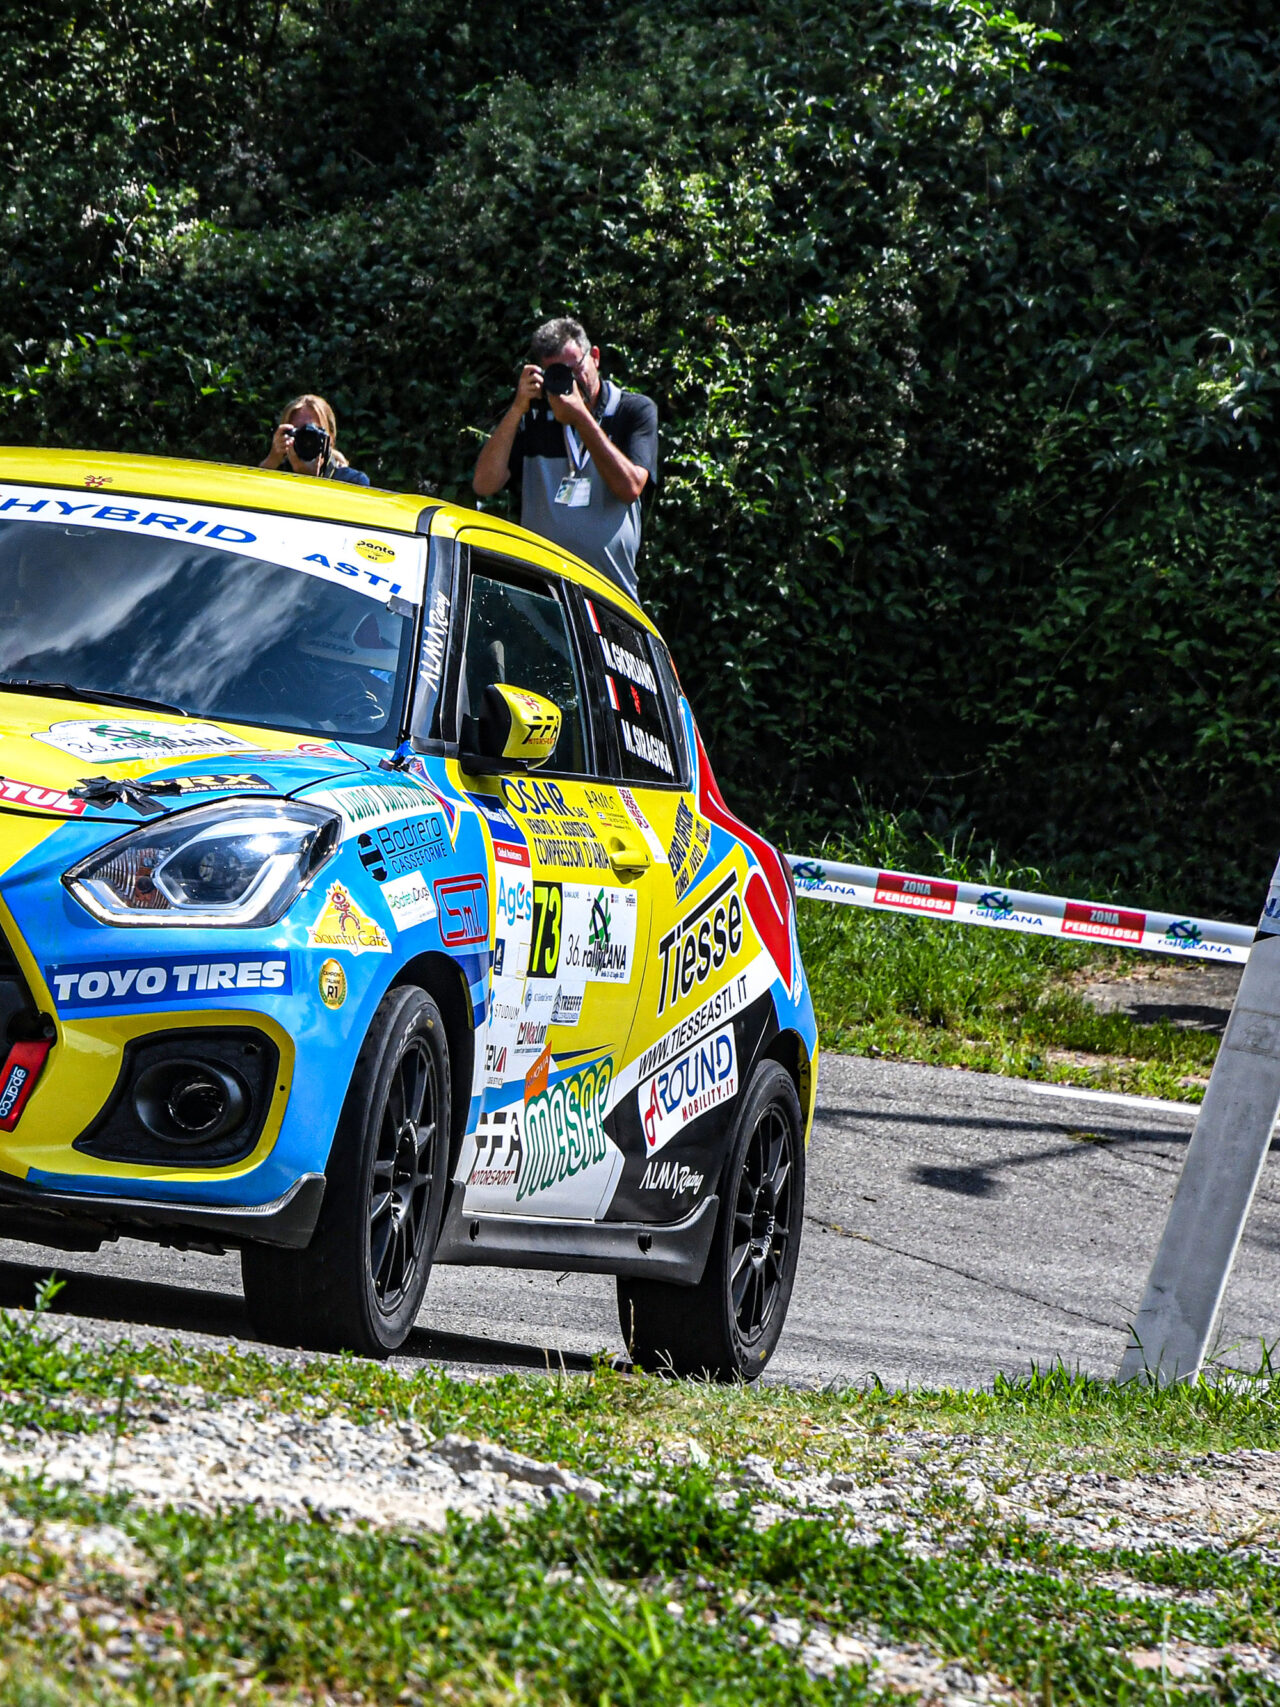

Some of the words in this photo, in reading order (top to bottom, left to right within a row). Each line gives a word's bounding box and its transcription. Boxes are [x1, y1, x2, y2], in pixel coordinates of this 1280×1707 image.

[302, 553, 402, 595] ASTI
[501, 778, 574, 817] OSAIR
[377, 817, 441, 854] Bodrero
[391, 842, 448, 874] CASSEFORME
[497, 876, 532, 926] Agos
[877, 892, 952, 911] PERICOLOSA
[902, 880, 931, 895] ZONA
[532, 886, 562, 975] 73
[1064, 921, 1140, 941] PERICOLOSA
[1090, 910, 1120, 925] ZONA
[566, 933, 580, 967] 36.
[658, 869, 742, 1016] Tiesse
[53, 967, 168, 1001] TOYO
[172, 960, 287, 992] TIRES
[327, 985, 338, 999] R1
[645, 1034, 733, 1147] AROUND
[681, 1079, 734, 1123] MOBILITY.IT
[470, 1169, 516, 1186] MOTORSPORT
[639, 1161, 680, 1190] ALMA
[672, 1165, 704, 1200] Racing
